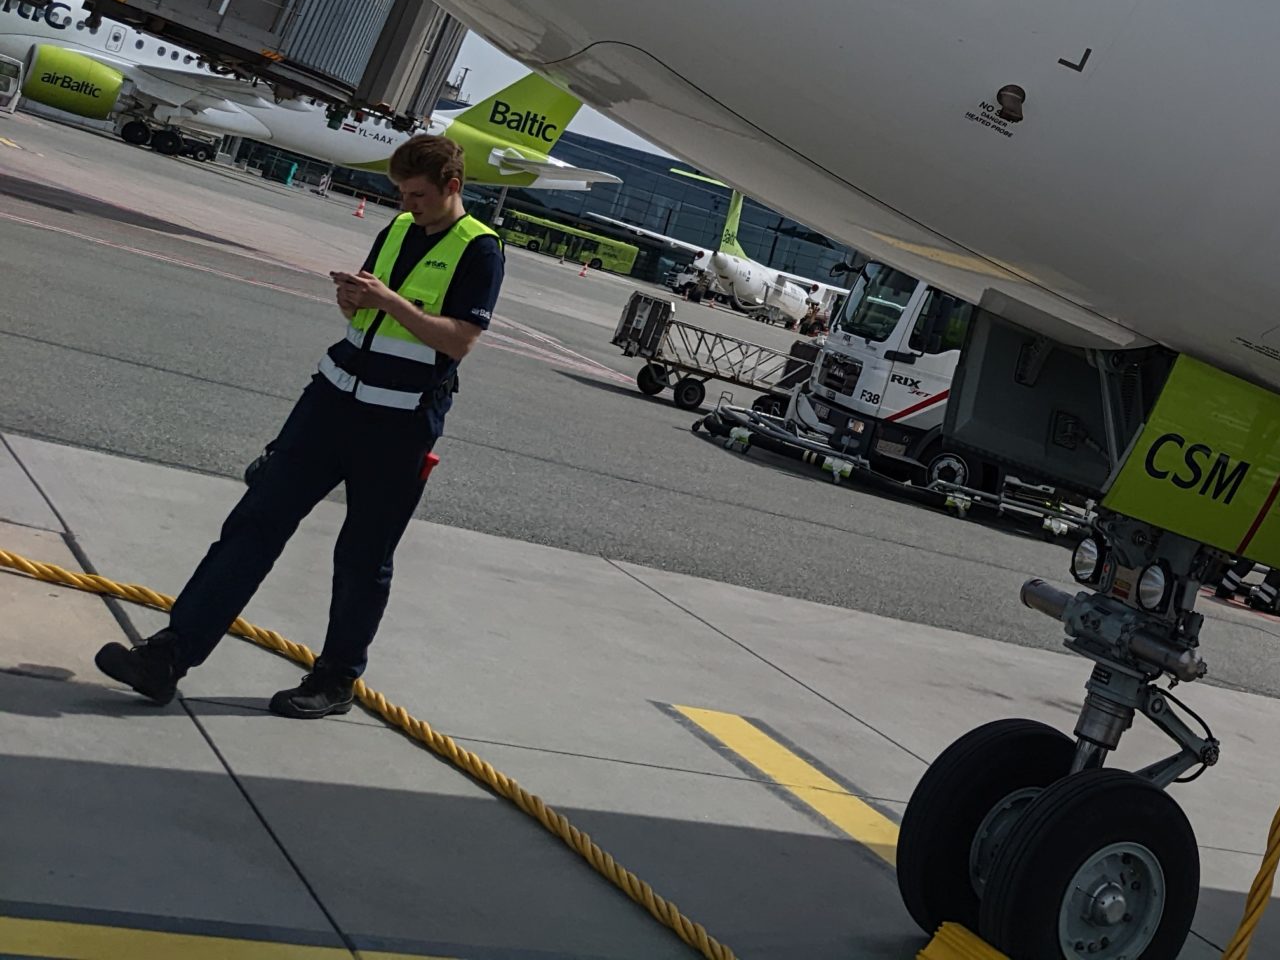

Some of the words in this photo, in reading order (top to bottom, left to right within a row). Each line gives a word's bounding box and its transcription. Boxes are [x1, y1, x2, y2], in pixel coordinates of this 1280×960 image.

[41, 72, 101, 98] airBaltic
[979, 101, 994, 112] NO
[489, 100, 557, 143] Baltic
[965, 112, 991, 127] HEATED
[991, 124, 1013, 138] PROBE
[981, 111, 1008, 127] DANGER
[358, 127, 394, 145] YL-AAX
[890, 373, 922, 390] RIX
[860, 389, 880, 405] F38
[1144, 433, 1251, 505] CSM
